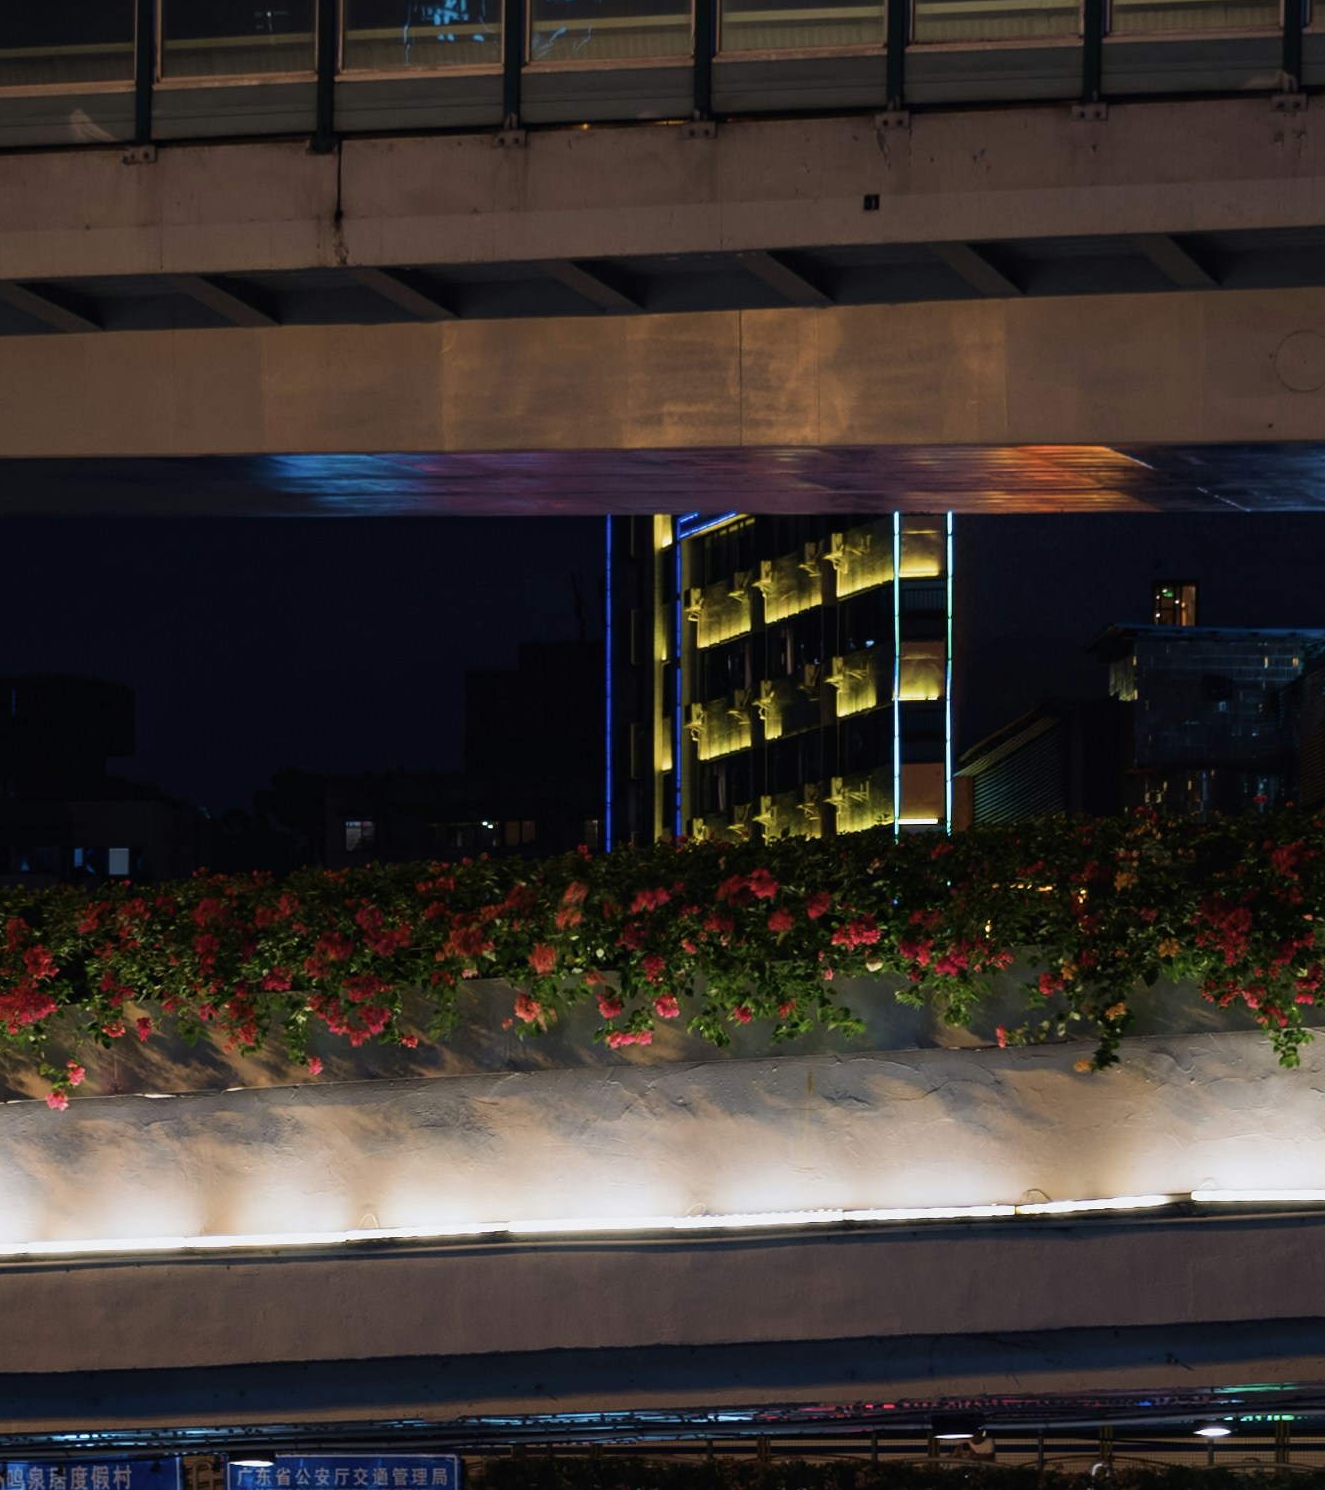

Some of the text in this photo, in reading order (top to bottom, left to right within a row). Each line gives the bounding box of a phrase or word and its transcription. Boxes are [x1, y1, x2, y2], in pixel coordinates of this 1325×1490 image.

[237, 1467, 448, 1487] 广东省公安厅交通管理局
